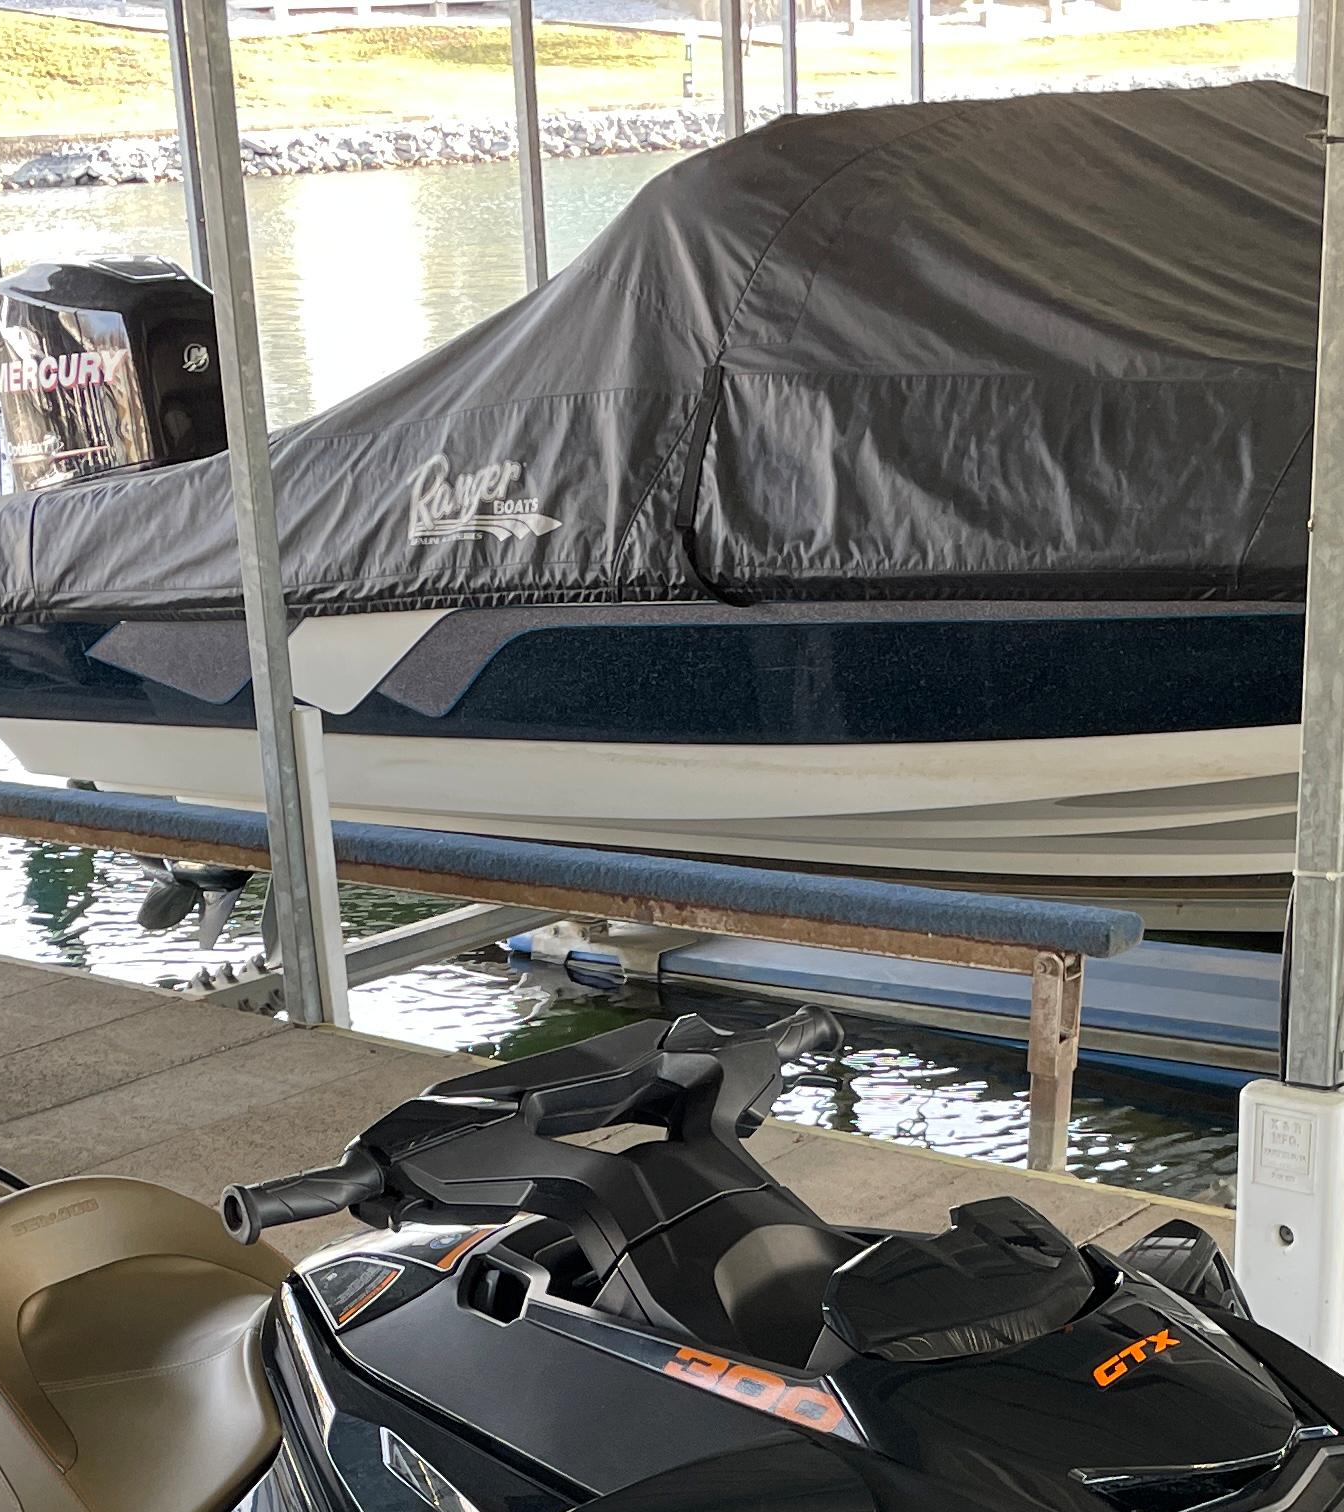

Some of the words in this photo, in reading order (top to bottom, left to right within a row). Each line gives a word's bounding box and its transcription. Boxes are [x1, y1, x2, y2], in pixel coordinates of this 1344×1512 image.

[405, 453, 523, 536] Ranger
[493, 497, 539, 515] BOATS
[663, 1346, 846, 1433] 300
[1093, 1328, 1182, 1387] GTX
